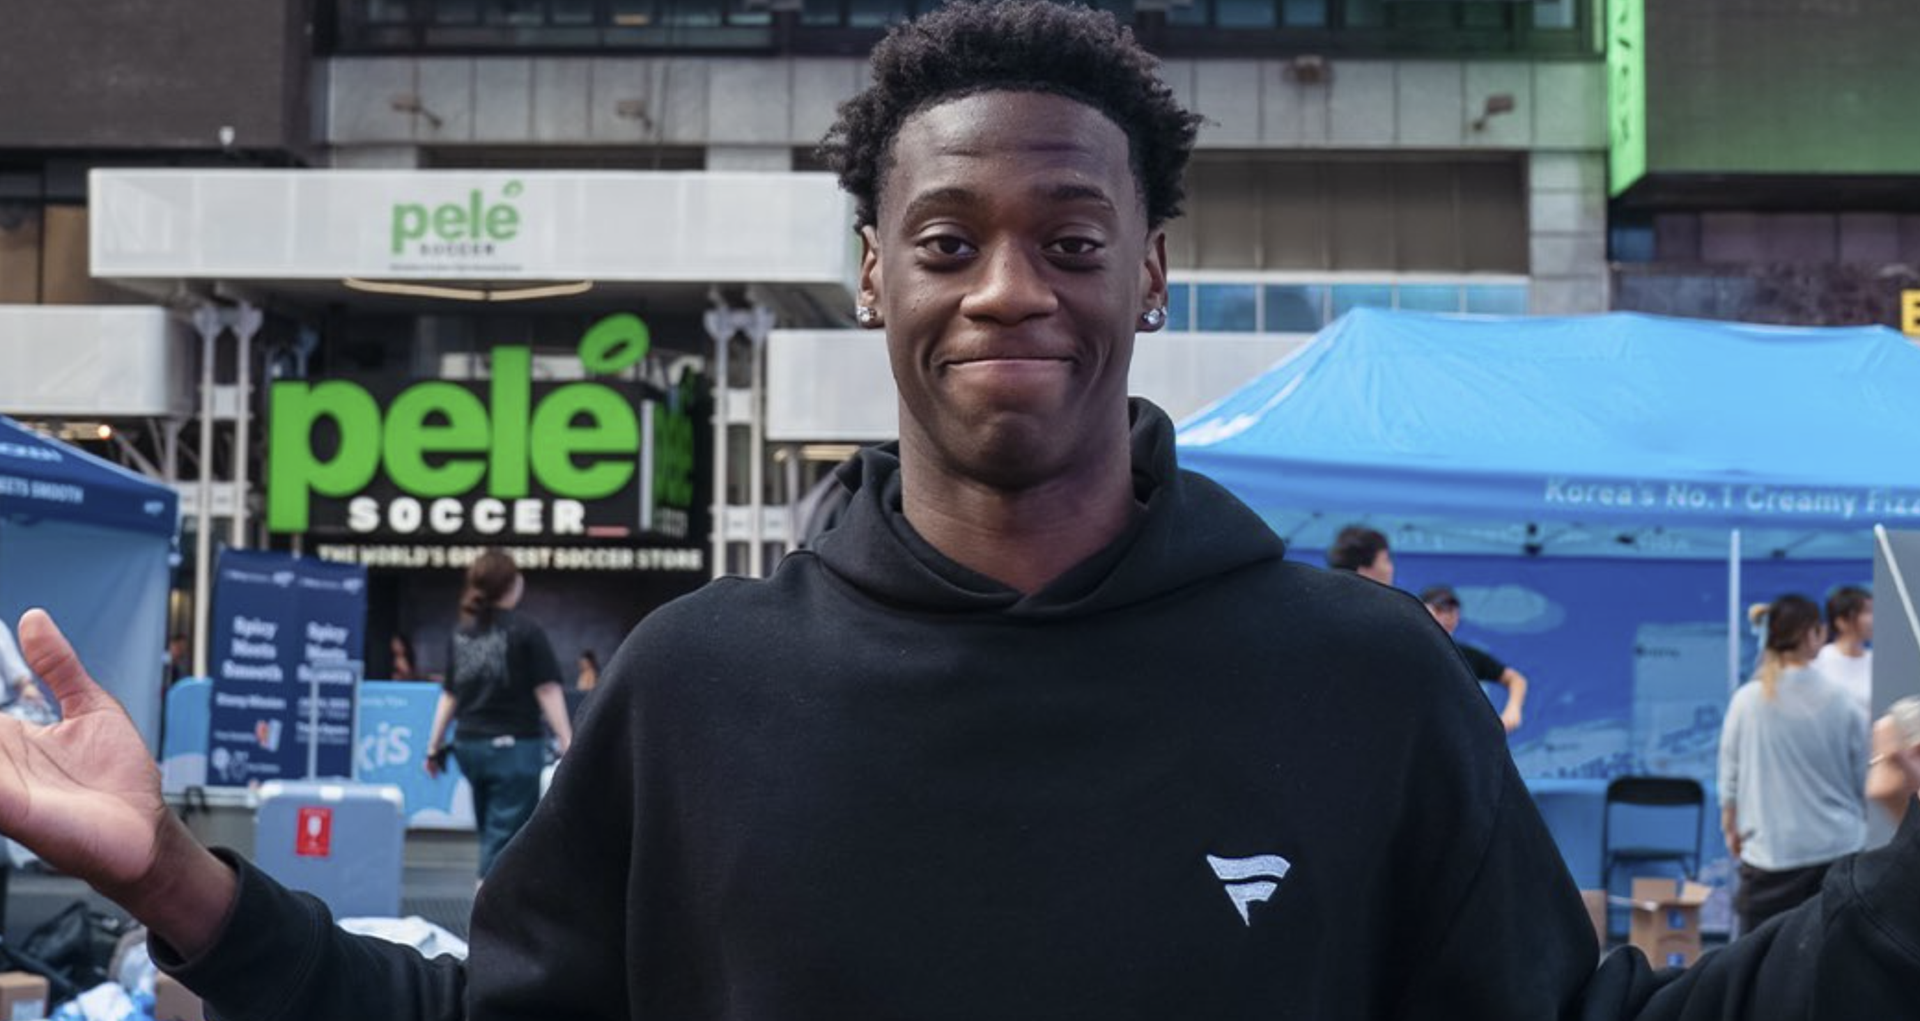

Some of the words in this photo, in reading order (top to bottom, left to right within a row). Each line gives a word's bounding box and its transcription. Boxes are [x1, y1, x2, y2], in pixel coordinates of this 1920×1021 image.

[392, 180, 524, 255] pelé
[267, 313, 650, 533] pelé
[30, 479, 84, 504] SMOOTH
[1545, 478, 1655, 506] Korea's
[1745, 486, 1854, 520] Creamy
[348, 497, 586, 535] SOCCER
[319, 545, 356, 563] THE
[359, 545, 445, 568] WORLD'S
[552, 547, 634, 569] SOCCER
[635, 548, 703, 571] STORE
[233, 615, 278, 640] Spicy
[222, 659, 283, 682] Smooth
